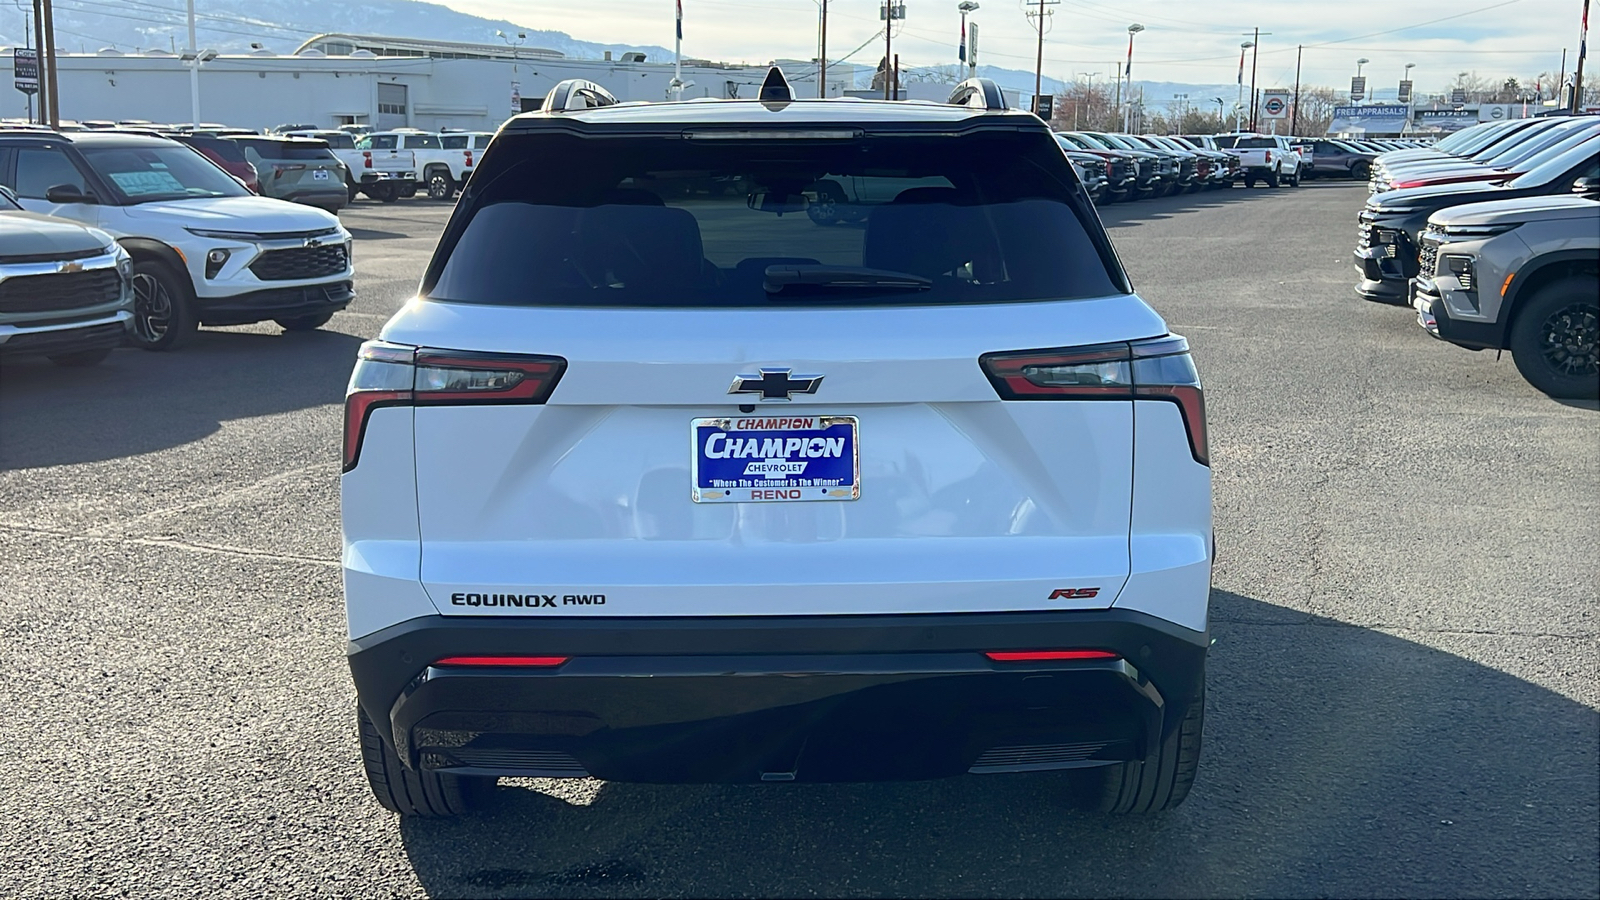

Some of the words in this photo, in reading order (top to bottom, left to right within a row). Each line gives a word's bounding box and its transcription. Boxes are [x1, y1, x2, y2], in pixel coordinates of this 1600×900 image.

[1336, 108, 1356, 116] FREE
[1357, 107, 1406, 116] APPRAISALS!
[736, 418, 814, 430] CHAMPION
[704, 432, 846, 459] CHAMPION
[747, 463, 803, 472] CHEVROLET
[739, 479, 752, 488] The
[754, 478, 789, 488] Customer
[790, 478, 797, 487] Is
[799, 478, 812, 487] The
[751, 489, 802, 500] RENO
[1047, 587, 1101, 600] RS
[451, 593, 558, 608] EQUINOX
[563, 594, 606, 606] AWD
